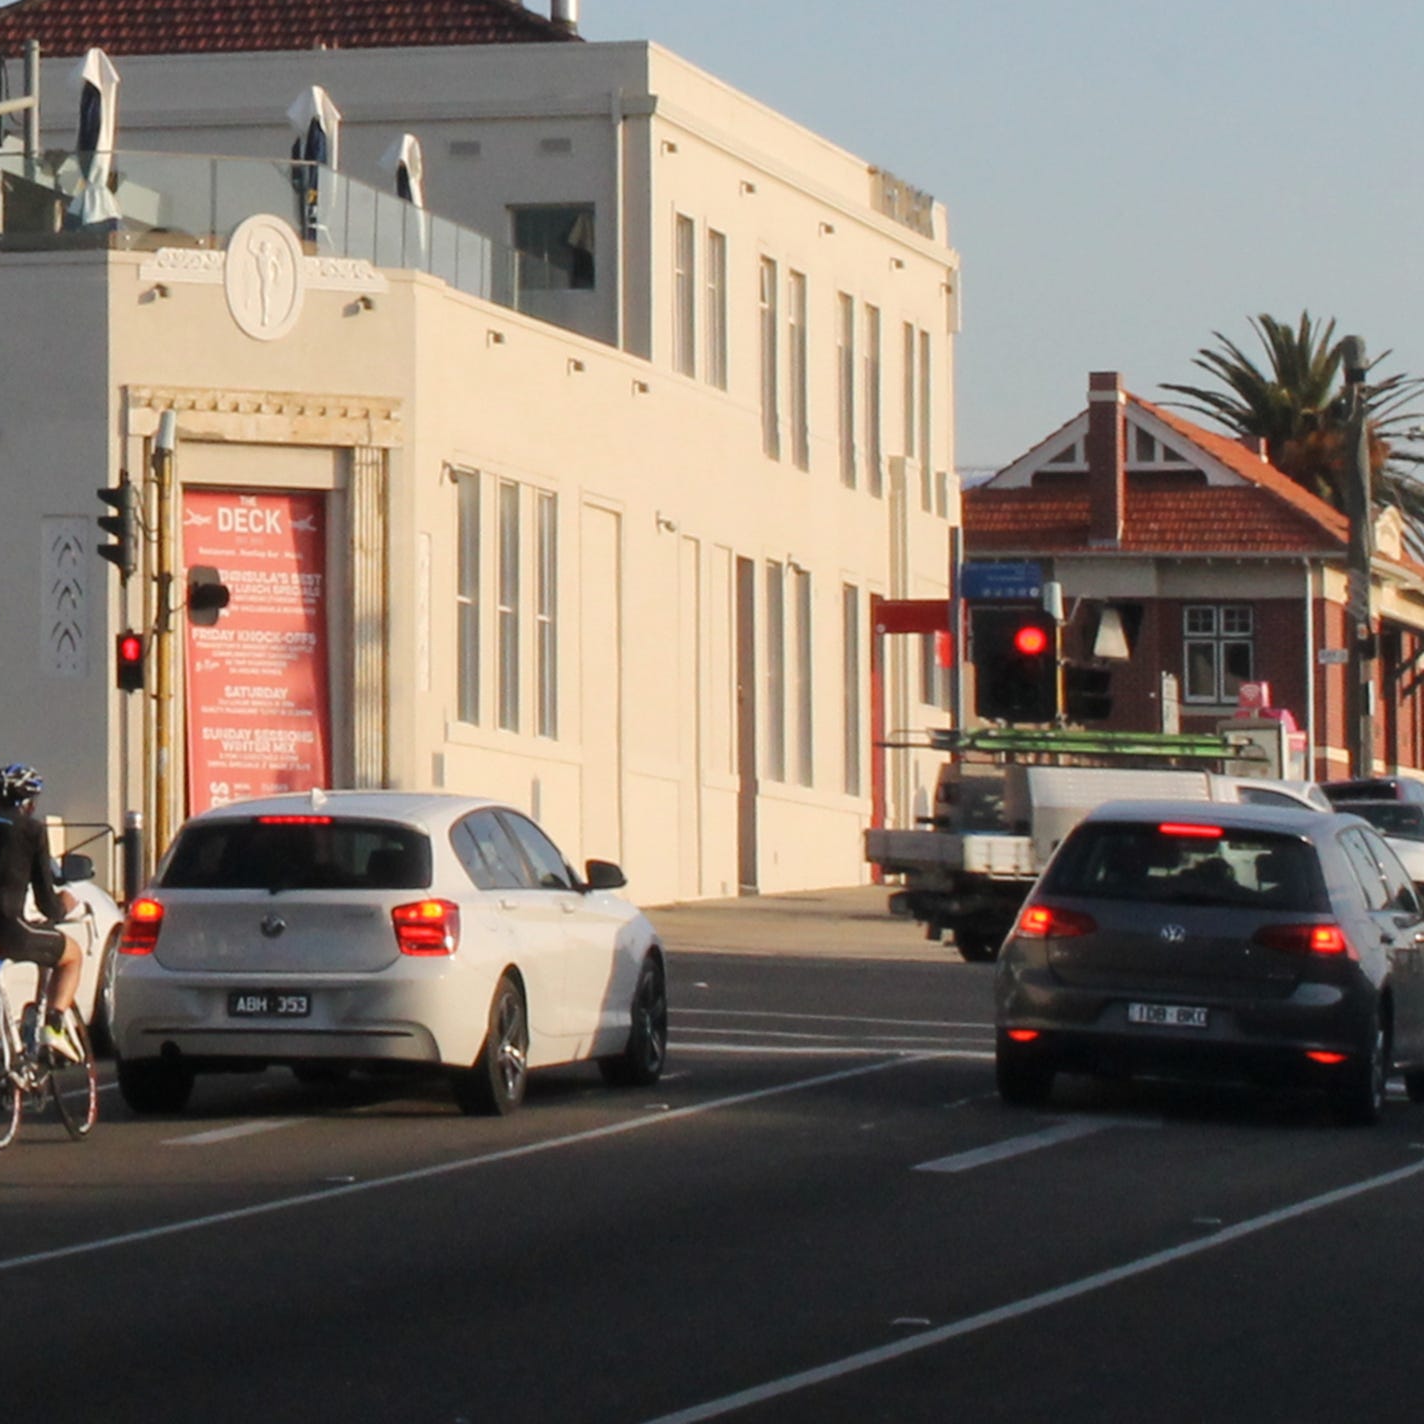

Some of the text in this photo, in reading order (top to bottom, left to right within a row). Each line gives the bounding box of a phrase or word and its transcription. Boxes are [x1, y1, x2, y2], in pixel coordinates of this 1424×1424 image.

[217, 507, 283, 534] DECK
[192, 627, 235, 642] FRIDAY
[224, 685, 288, 699] SATURDAY
[202, 727, 252, 741] SUNDAY
